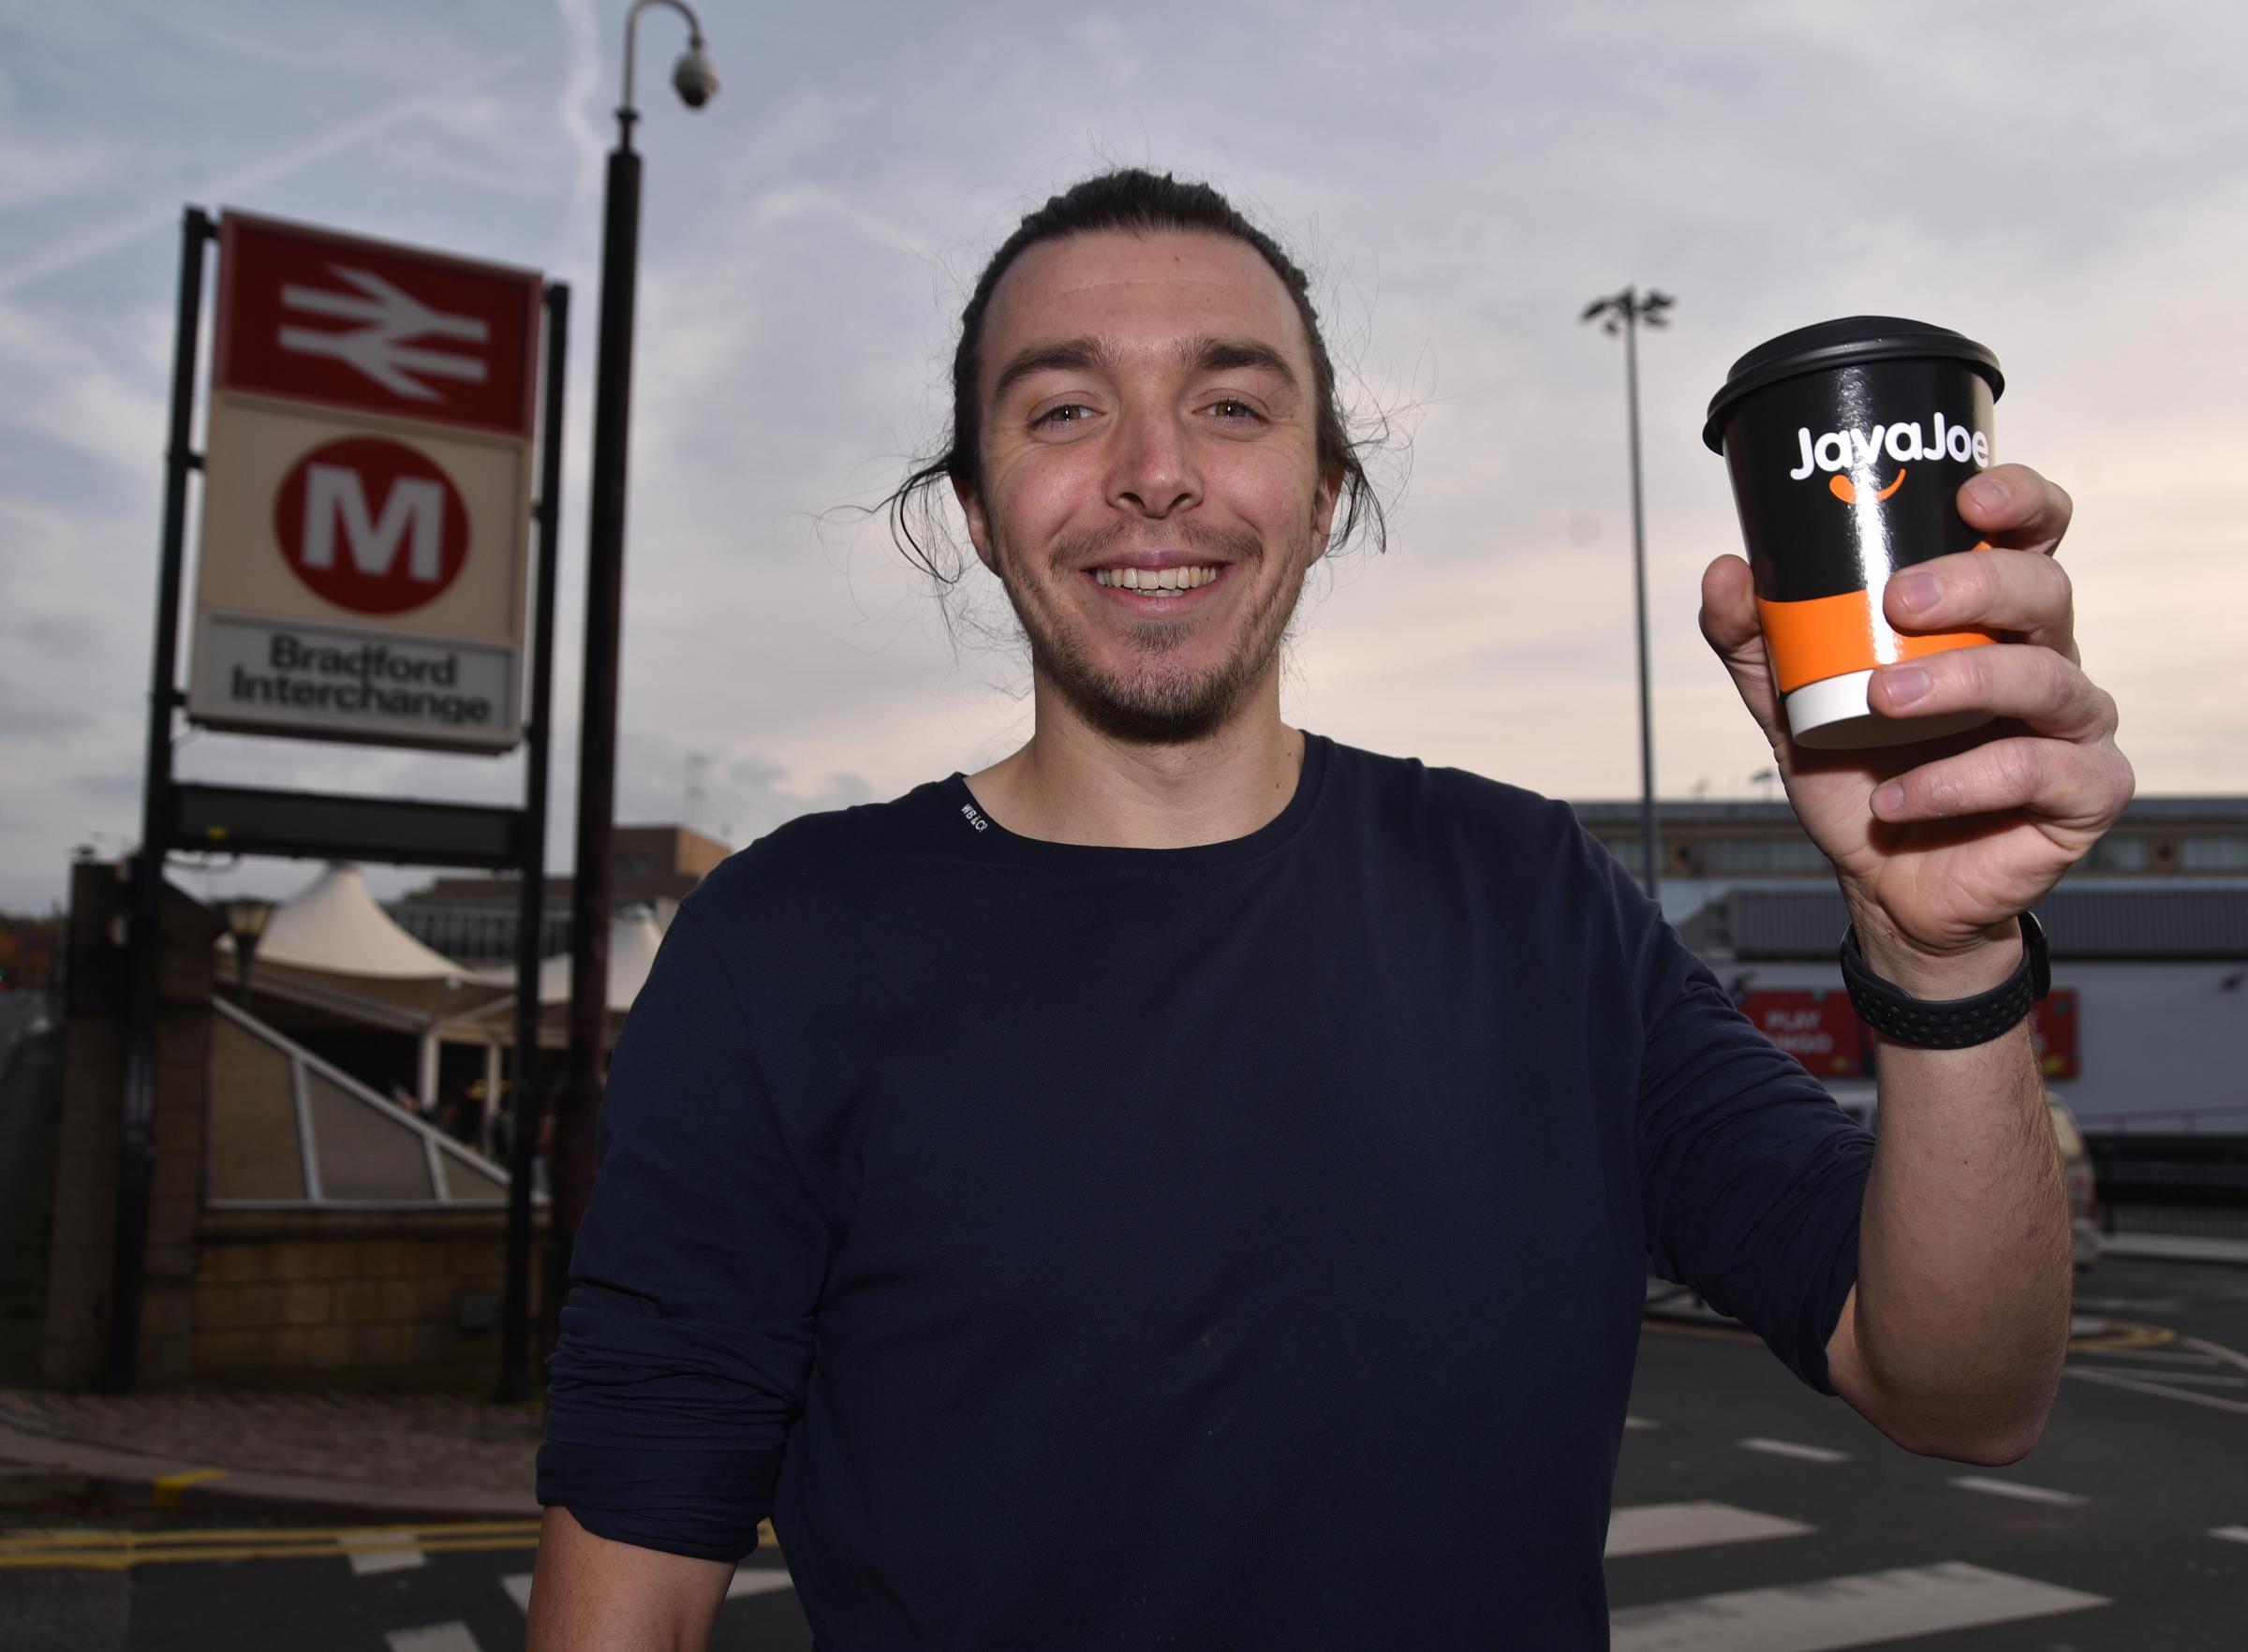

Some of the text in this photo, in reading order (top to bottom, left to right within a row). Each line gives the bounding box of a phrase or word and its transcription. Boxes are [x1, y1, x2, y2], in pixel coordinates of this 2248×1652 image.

[300, 465, 443, 583] M
[269, 635, 458, 686] Bradford
[230, 665, 491, 723] Interchange
[1767, 1010, 1820, 1029] PLAY
